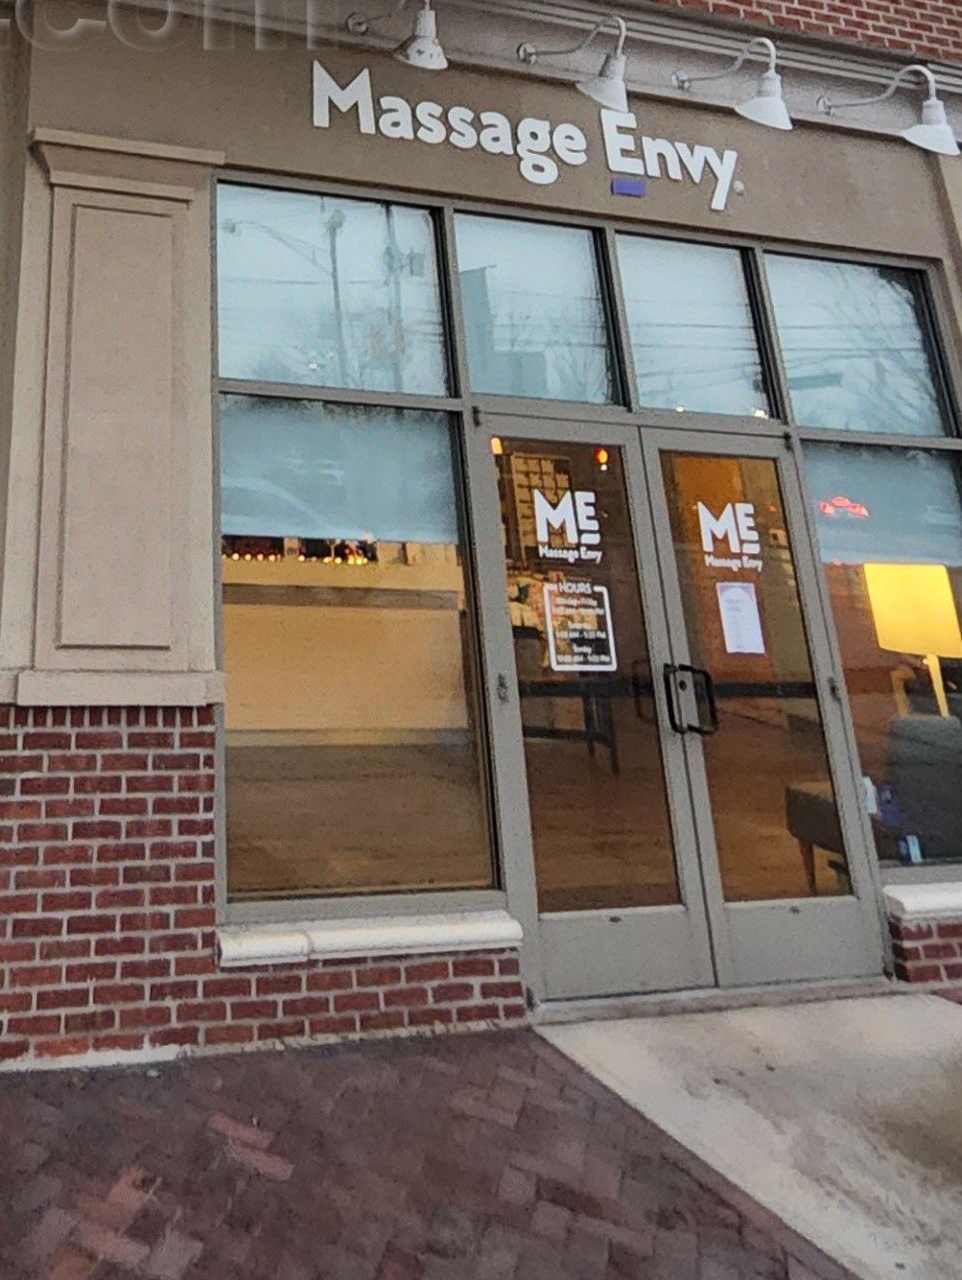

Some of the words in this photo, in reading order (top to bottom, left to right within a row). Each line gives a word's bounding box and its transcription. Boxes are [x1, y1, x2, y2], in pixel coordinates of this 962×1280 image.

[311, 60, 588, 185] Massage
[600, 108, 738, 212] Envy
[533, 488, 601, 545] ME
[697, 501, 761, 554] ME
[538, 544, 579, 563] Massage
[558, 581, 592, 595] HOURS
